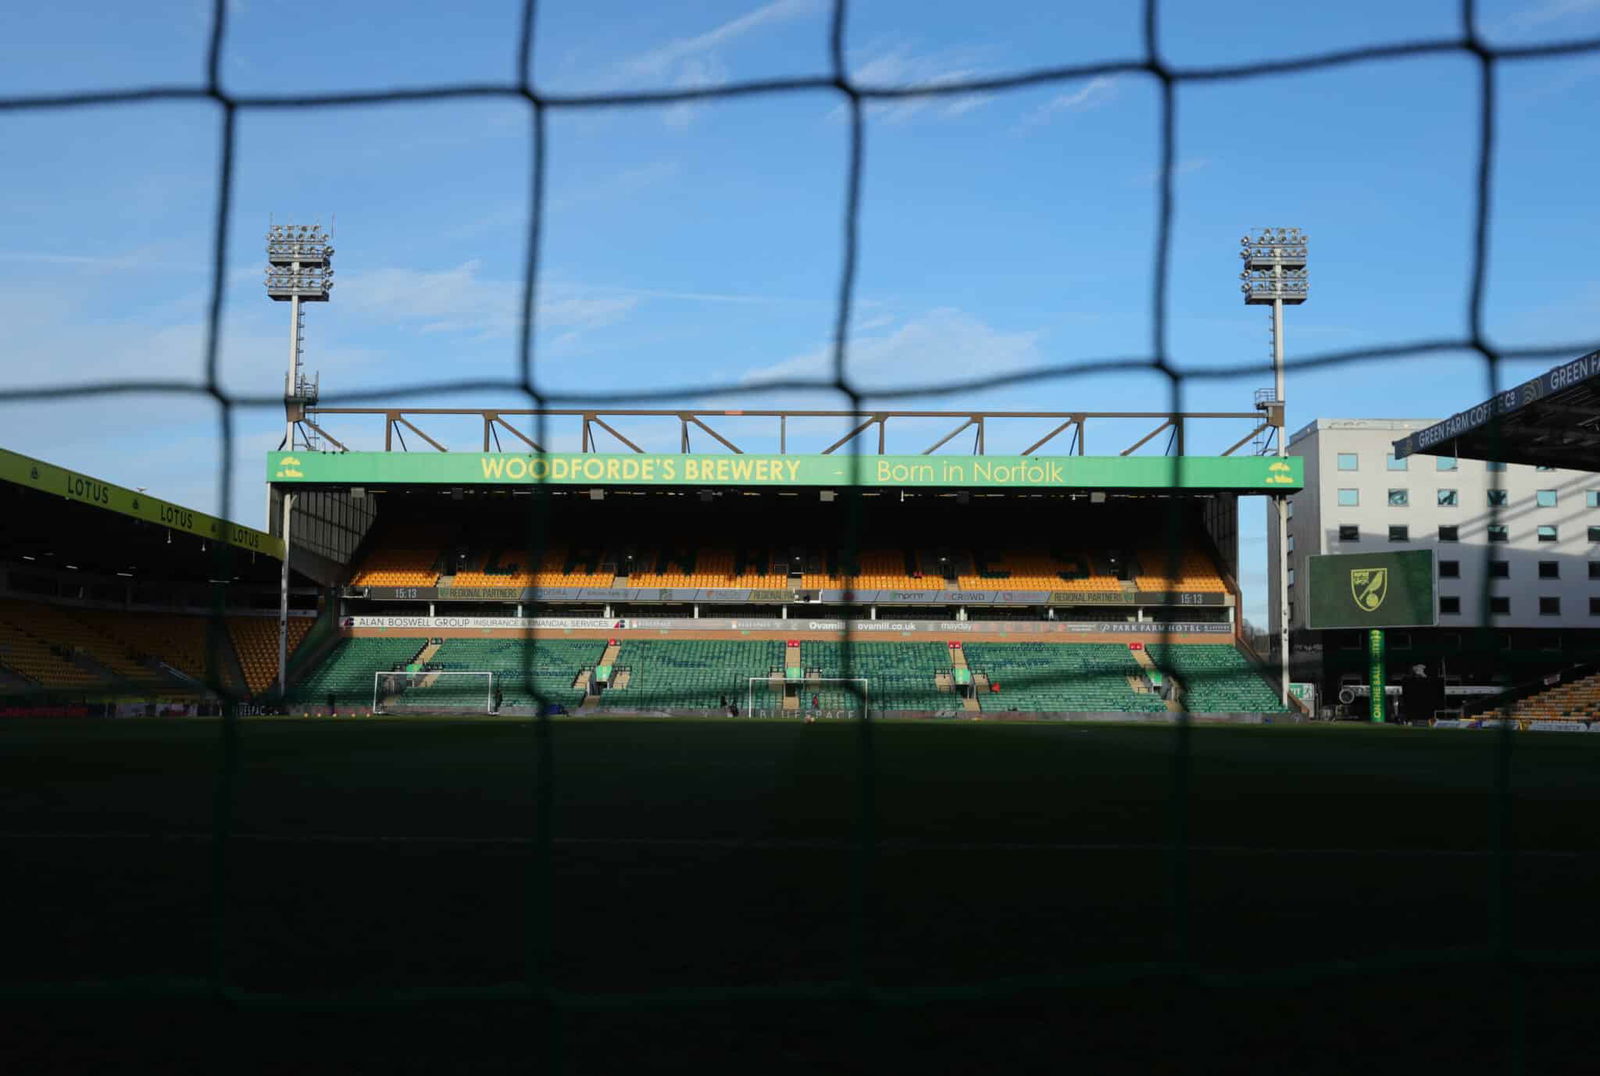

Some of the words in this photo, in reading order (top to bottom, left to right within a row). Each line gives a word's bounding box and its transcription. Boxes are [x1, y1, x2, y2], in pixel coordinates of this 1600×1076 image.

[1550, 358, 1588, 390] GREEN
[1418, 425, 1445, 448] GREEN
[1446, 413, 1469, 437] FARM
[481, 457, 677, 481] WOODFORDE'S
[684, 458, 801, 481] BREWERY
[877, 460, 934, 482] Born
[943, 460, 964, 482] in
[974, 459, 1064, 483] Norfolk
[67, 475, 109, 504] LOTUS
[160, 503, 193, 529] LOTUS
[232, 527, 259, 549] LOTUS
[395, 588, 417, 598] 15:13
[482, 588, 517, 598] PARTNERS
[359, 618, 385, 627] ALAN
[388, 618, 429, 627] BOSWELL
[434, 618, 470, 627] GROUP
[1112, 624, 1138, 632] PARK
